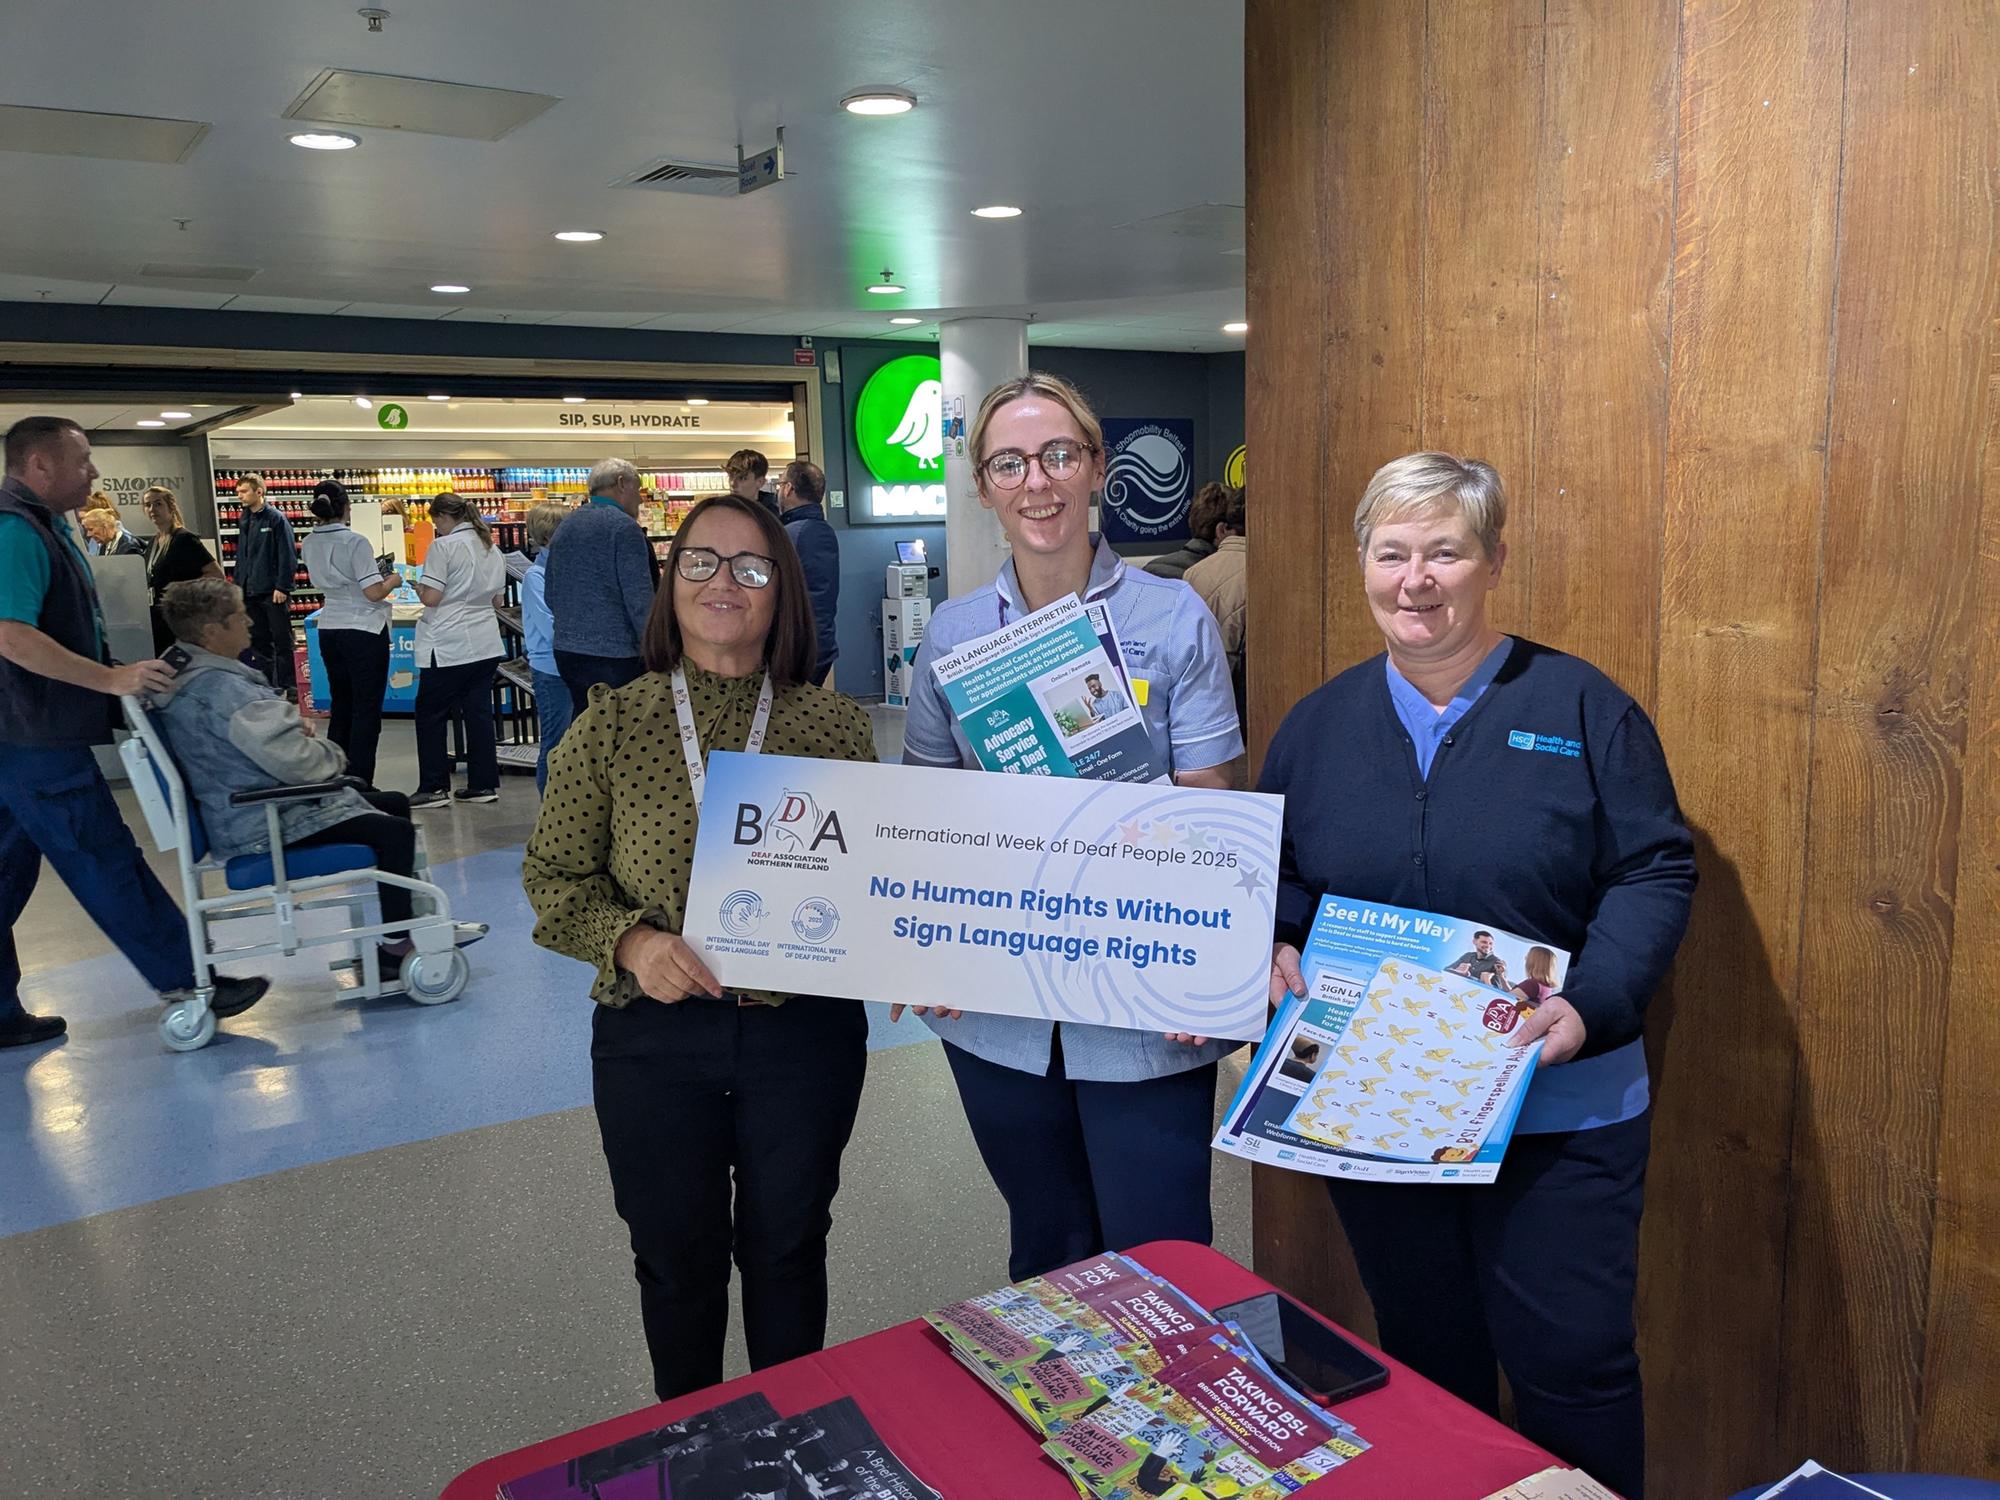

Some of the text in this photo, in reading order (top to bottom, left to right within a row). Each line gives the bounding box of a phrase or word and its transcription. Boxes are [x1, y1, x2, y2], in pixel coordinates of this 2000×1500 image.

[559, 413, 700, 428] SIP, SUP, HYDRATE
[1116, 425, 1186, 453] Shopmobility Belfast
[103, 477, 184, 491] SMOKIN'
[118, 492, 143, 506] BE
[1120, 513, 1139, 532] Charity
[1140, 525, 1157, 535] going
[1158, 523, 1168, 532] the
[1169, 514, 1182, 528] extra
[1182, 499, 1191, 516] mile
[938, 600, 1078, 674] SIGN LANGUAGE INTERPRETING
[963, 662, 975, 673] Sign
[974, 650, 1000, 667] Language
[1000, 645, 1013, 655] (BSL)
[1029, 630, 1041, 639] Sign
[1041, 618, 1066, 635] Language
[961, 630, 1076, 688] Health & Social Care professionals.
[1129, 648, 1145, 656] Care
[966, 636, 1079, 695] make sure you book an interpreter
[968, 643, 1085, 703] for appointments with Deaf people
[1051, 660, 1091, 683] Online Remote
[984, 717, 1034, 752] Advocacy
[1512, 735, 1581, 748] HSC Health and
[996, 734, 1038, 763] Service
[1020, 745, 1047, 768] Deaf
[1085, 750, 1101, 762] 24/7
[1535, 744, 1580, 757] Social Care
[1079, 750, 1122, 775] Email One Form
[1103, 769, 1116, 778] 7712
[734, 796, 848, 854] BDA
[875, 823, 1238, 869] International Week of Deaf People 2025
[747, 859, 829, 871] NORTHERN IRELAND
[774, 853, 828, 864] ASSOCIATION
[869, 876, 1232, 931] No Human Rights Without
[1323, 902, 1456, 942] See It My Way
[706, 936, 770, 948] INTERNATIONAL DAY
[731, 947, 769, 956] LANGUAGES
[777, 943, 828, 954] INTERNATIONAL
[893, 916, 1198, 969] Sign Language Rights
[812, 955, 837, 963] PEOPLE
[1320, 984, 1346, 995] SIGN
[1322, 1020, 1334, 1028] for
[1324, 1014, 1346, 1024] make
[1328, 1007, 1352, 1017] Healt
[1487, 1002, 1511, 1032] BDA
[1456, 1064, 1518, 1144] BSL Fingerspelling
[1265, 1128, 1298, 1142] Webform:
[1093, 1263, 1120, 1280] TAK
[1141, 1290, 1186, 1328] TAKING
[1119, 1317, 1148, 1341] SUMMARY
[1141, 1327, 1157, 1339] ASSO
[1214, 1379, 1290, 1441] FORWARD
[1226, 1367, 1284, 1414] TAKING
[1278, 1411, 1309, 1437] BSL
[1197, 1382, 1223, 1404] BRITISH
[1220, 1402, 1240, 1417] DEAF
[1237, 1418, 1283, 1452] ASSOCIATION
[1212, 1406, 1251, 1437] SUMMARY
[861, 1449, 877, 1459] A
[870, 1457, 898, 1479] Brief
[855, 1466, 872, 1475] of
[864, 1476, 880, 1491] the
[1275, 1473, 1297, 1489] DEAF
